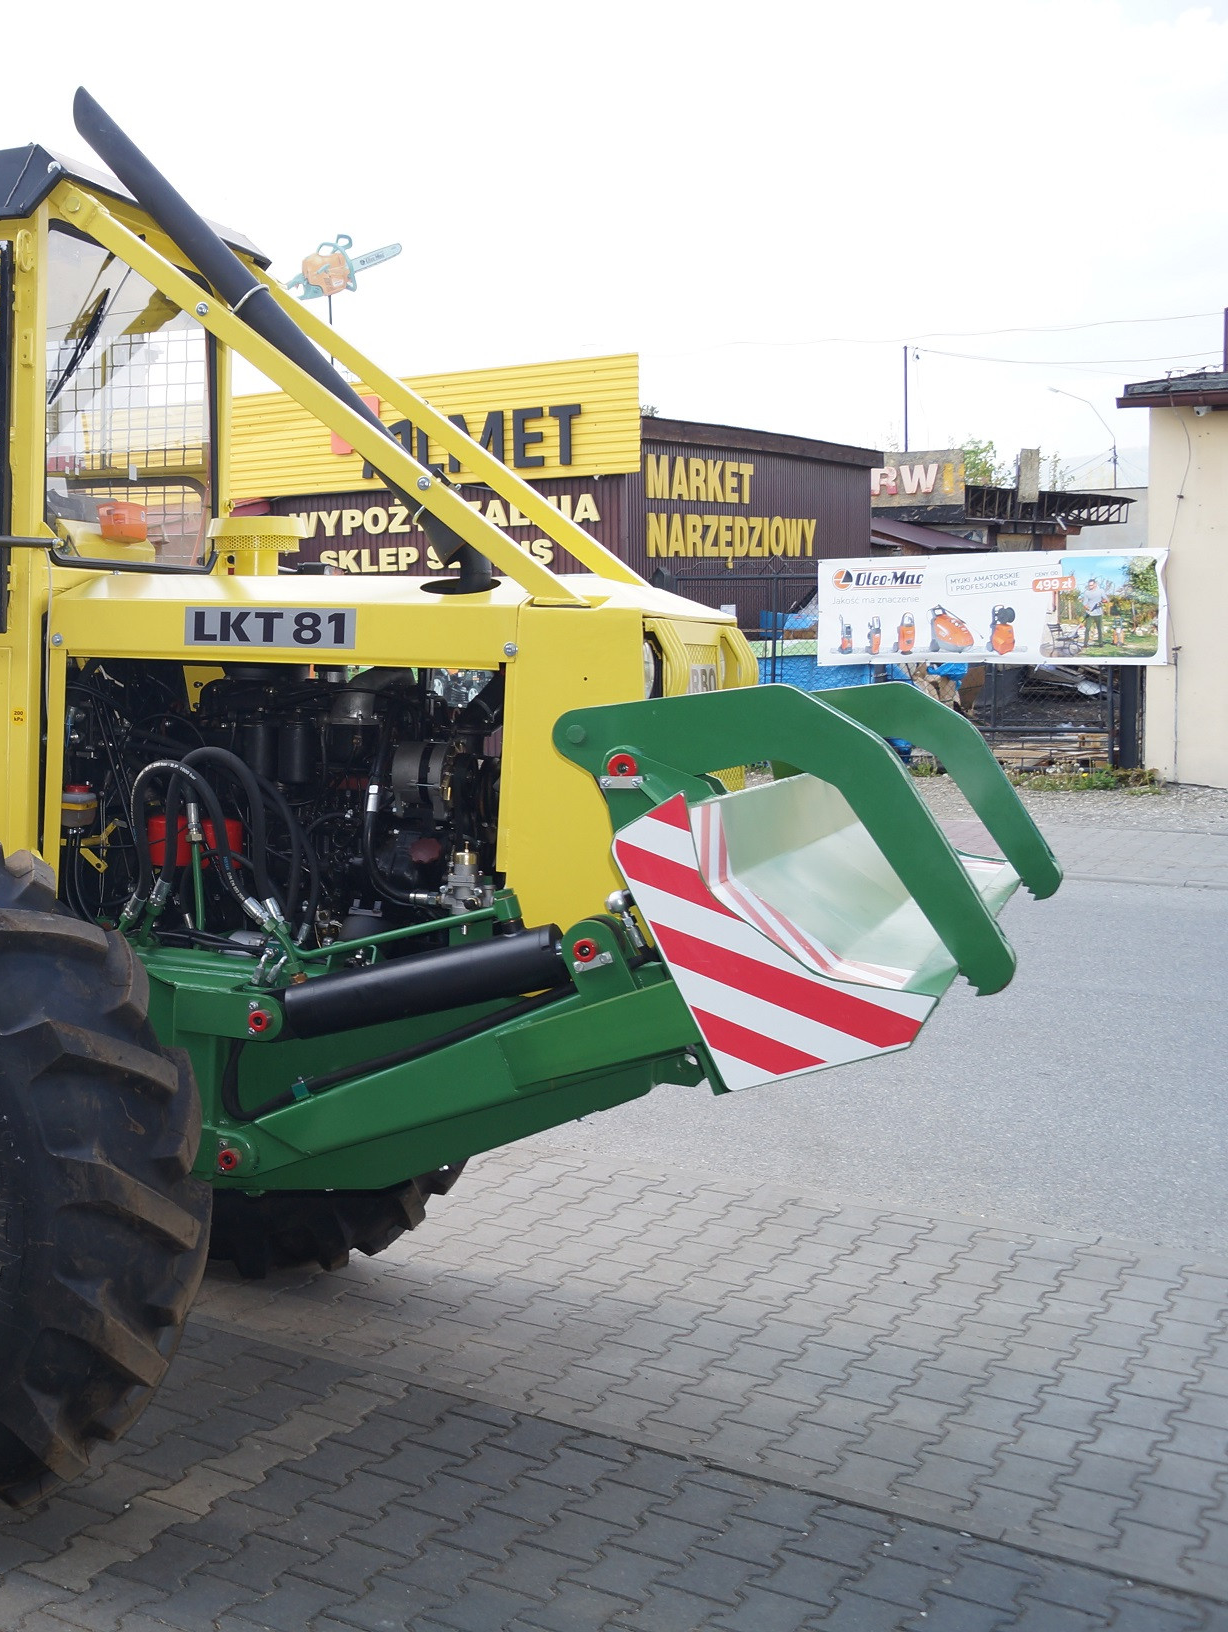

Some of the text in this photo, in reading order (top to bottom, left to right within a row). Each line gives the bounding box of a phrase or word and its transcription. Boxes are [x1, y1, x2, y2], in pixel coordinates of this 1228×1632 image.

[646, 453, 754, 505] MARKET
[646, 512, 817, 569] NARZĘDZIOWY
[855, 571, 924, 587] Oleo-Mac
[950, 572, 1021, 585] MYJKI AMATORSKIE
[1035, 578, 1073, 590] 499 zł
[955, 581, 1018, 592] PROFESJONALNE
[832, 596, 860, 605] Jakość
[877, 595, 920, 604] znaczenie
[194, 611, 346, 645] LKT 81
